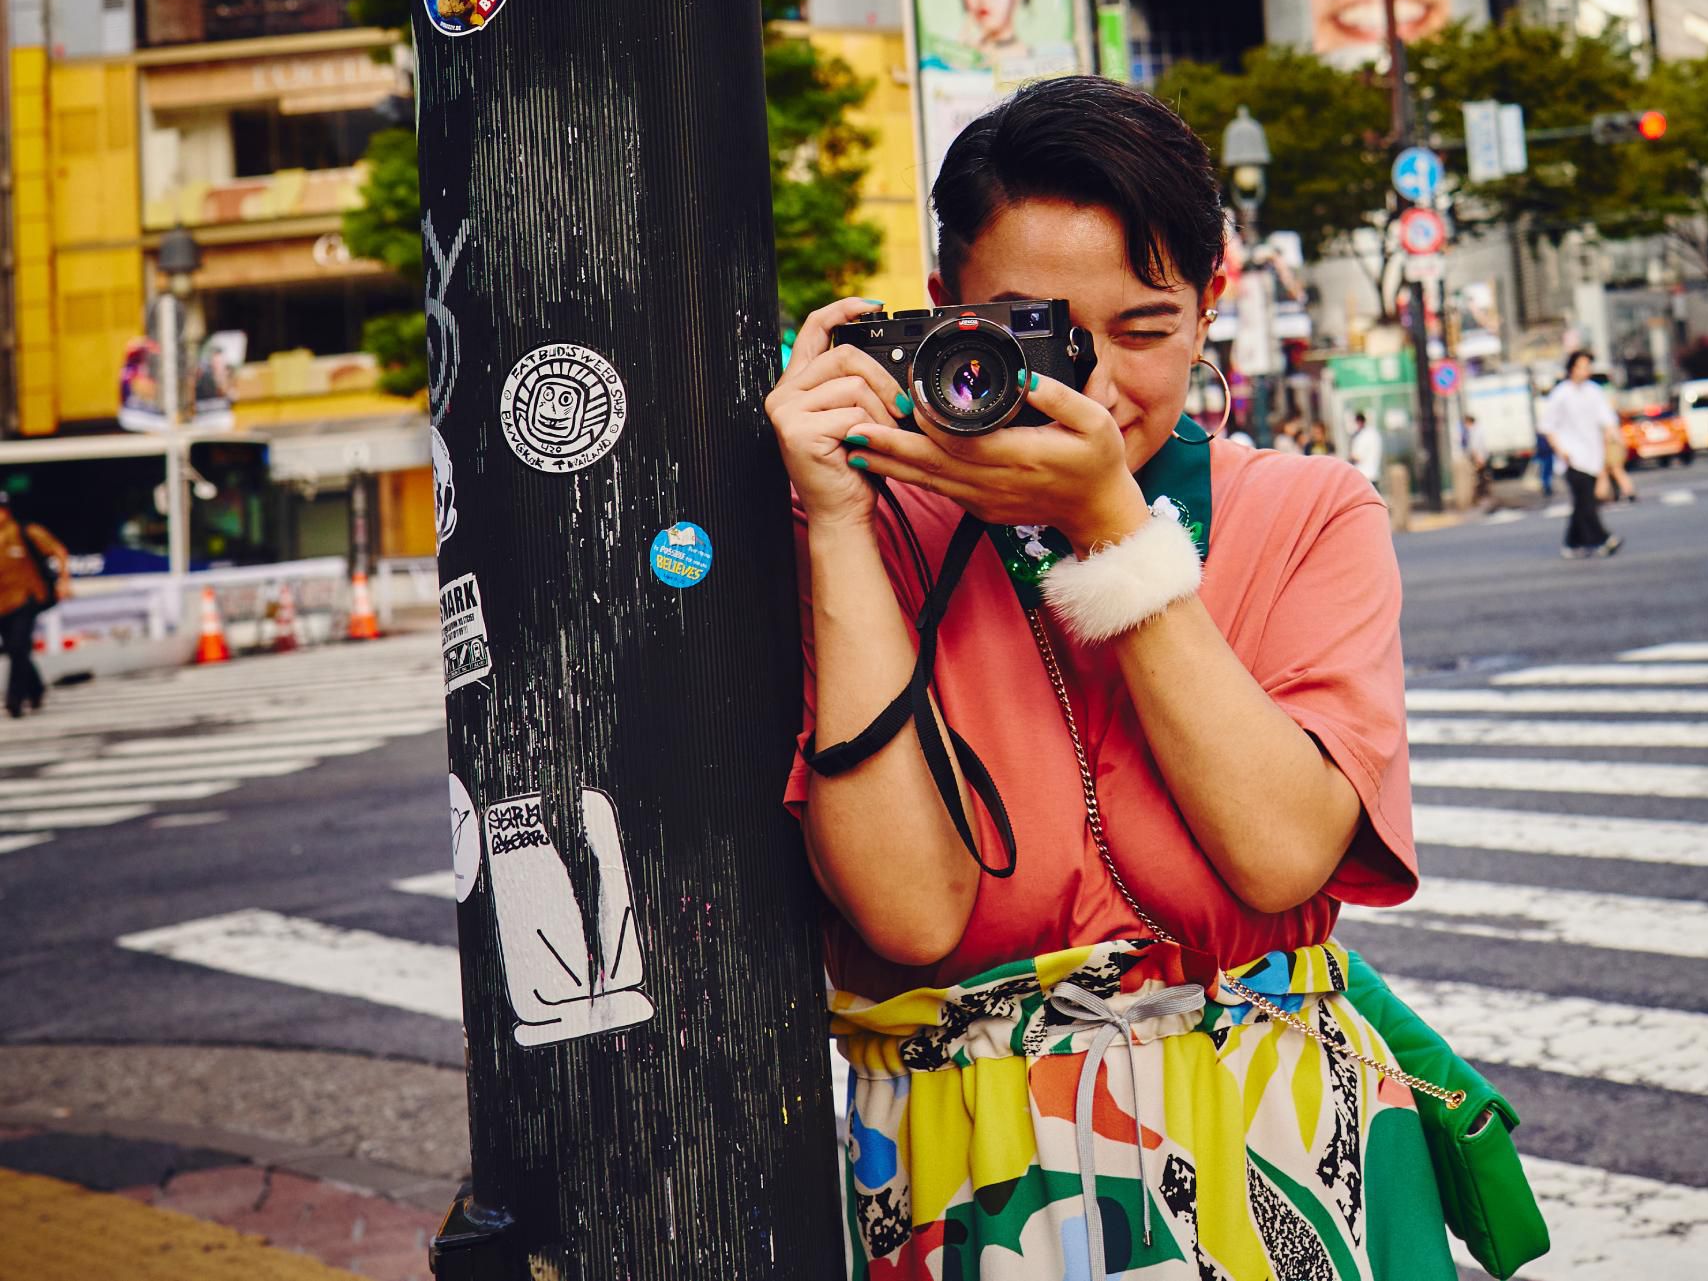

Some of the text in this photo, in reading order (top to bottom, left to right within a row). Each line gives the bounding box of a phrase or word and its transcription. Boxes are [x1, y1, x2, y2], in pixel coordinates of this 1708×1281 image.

[870, 328, 884, 338] M
[511, 353, 536, 380] FAT
[581, 350, 618, 384] WEED
[610, 387, 625, 419] SHOP
[501, 410, 612, 471] BANGKOK THAILAND
[540, 443, 562, 454] 420
[656, 554, 704, 581] BELIEVES
